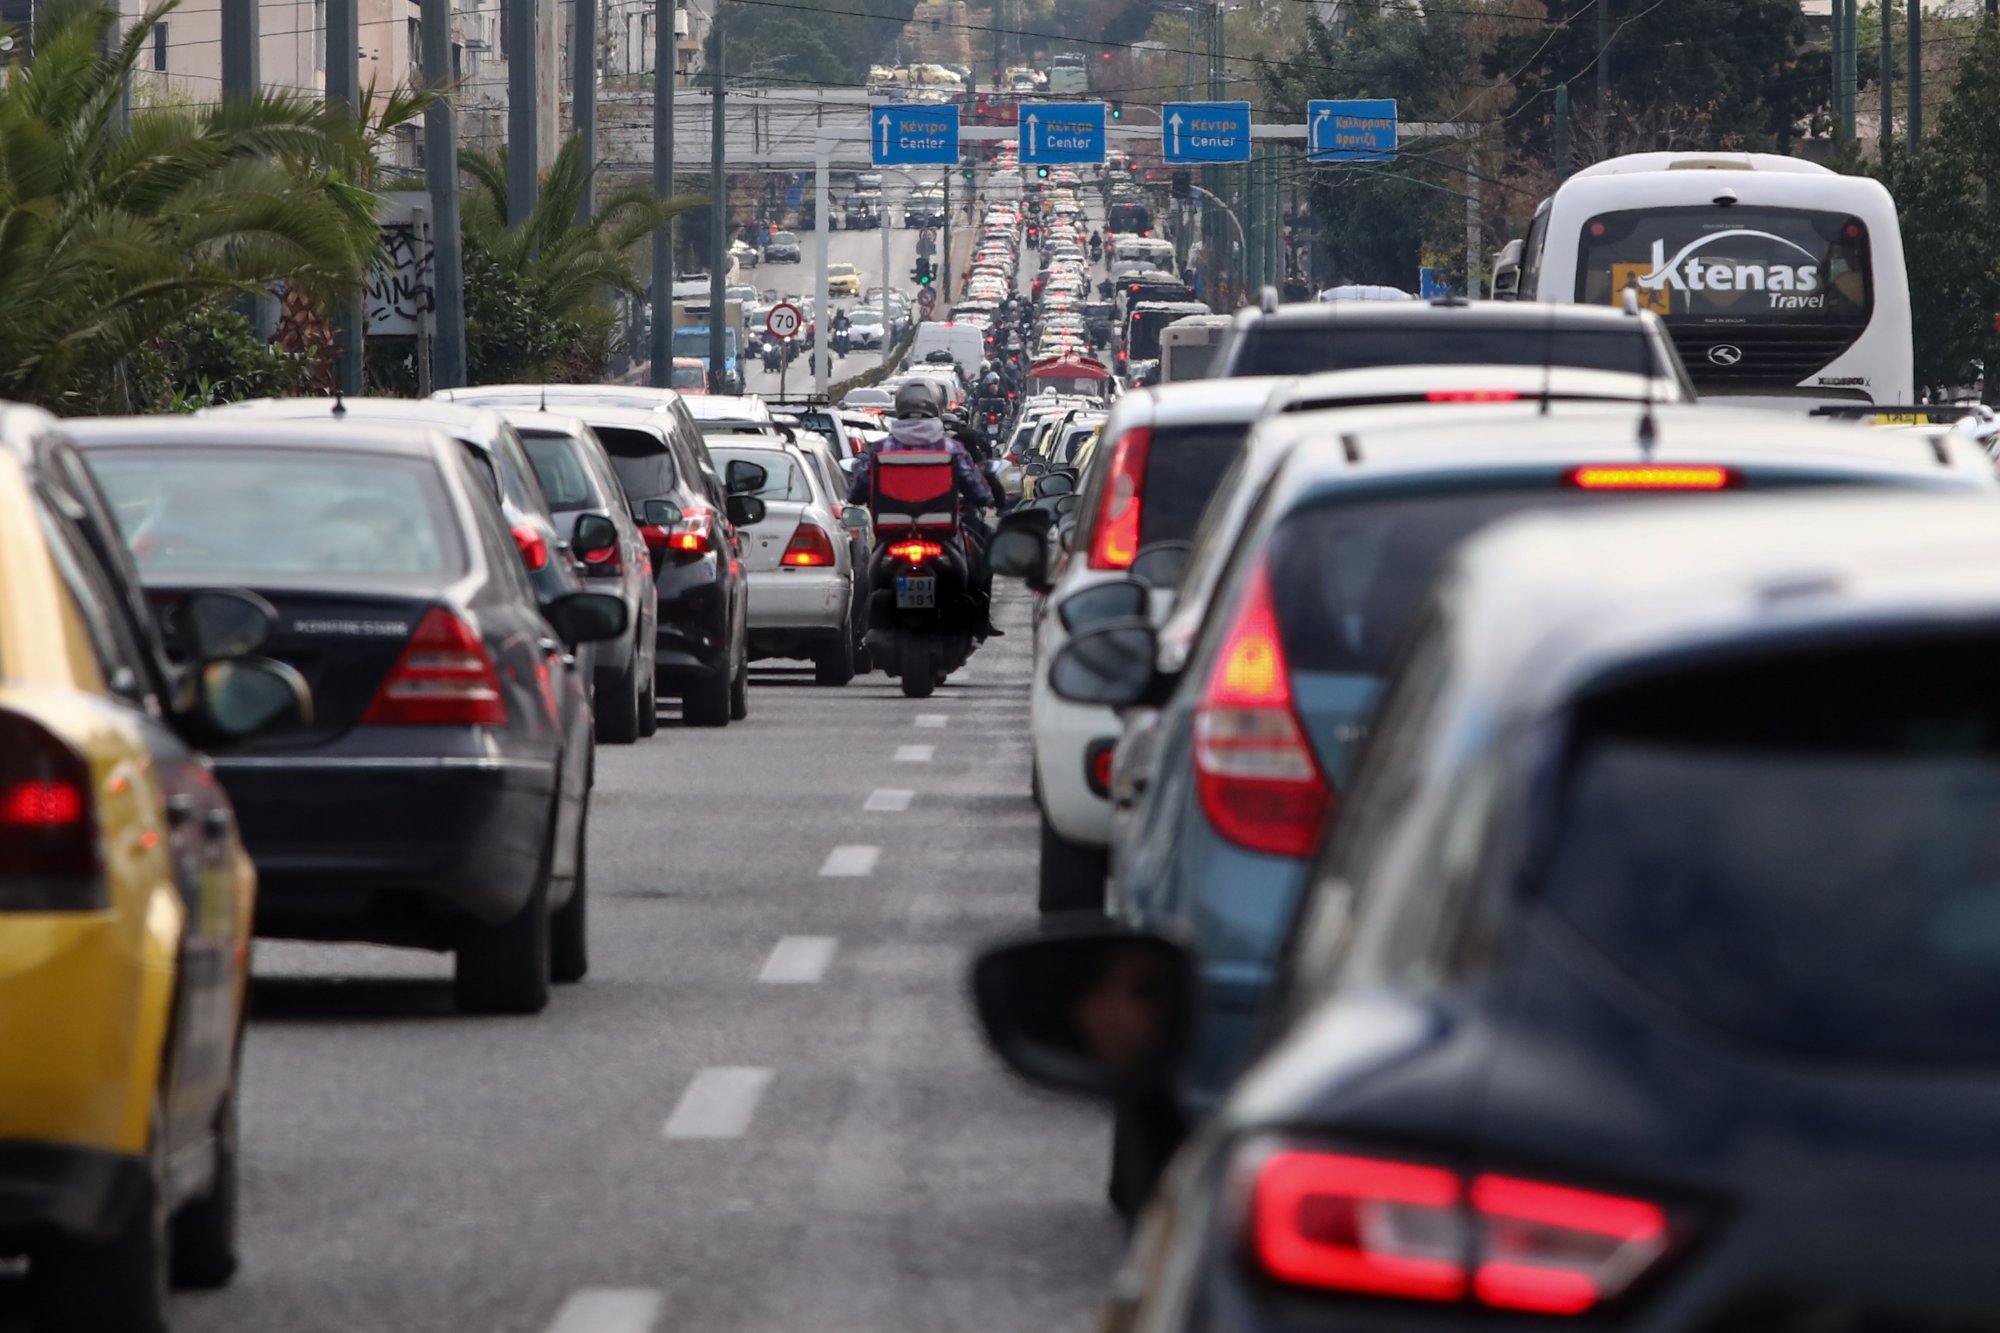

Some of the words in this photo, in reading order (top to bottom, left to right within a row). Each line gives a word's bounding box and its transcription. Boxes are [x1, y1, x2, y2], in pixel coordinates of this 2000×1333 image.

[899, 119, 947, 135] Κέντρο
[1191, 118, 1237, 133] Κέντρο
[900, 136, 945, 149] Center
[1047, 136, 1091, 149] Center
[1191, 135, 1235, 147] Center
[1638, 236, 1818, 291] Ktenas
[1768, 292, 1824, 308] Travel
[775, 314, 794, 329] 70
